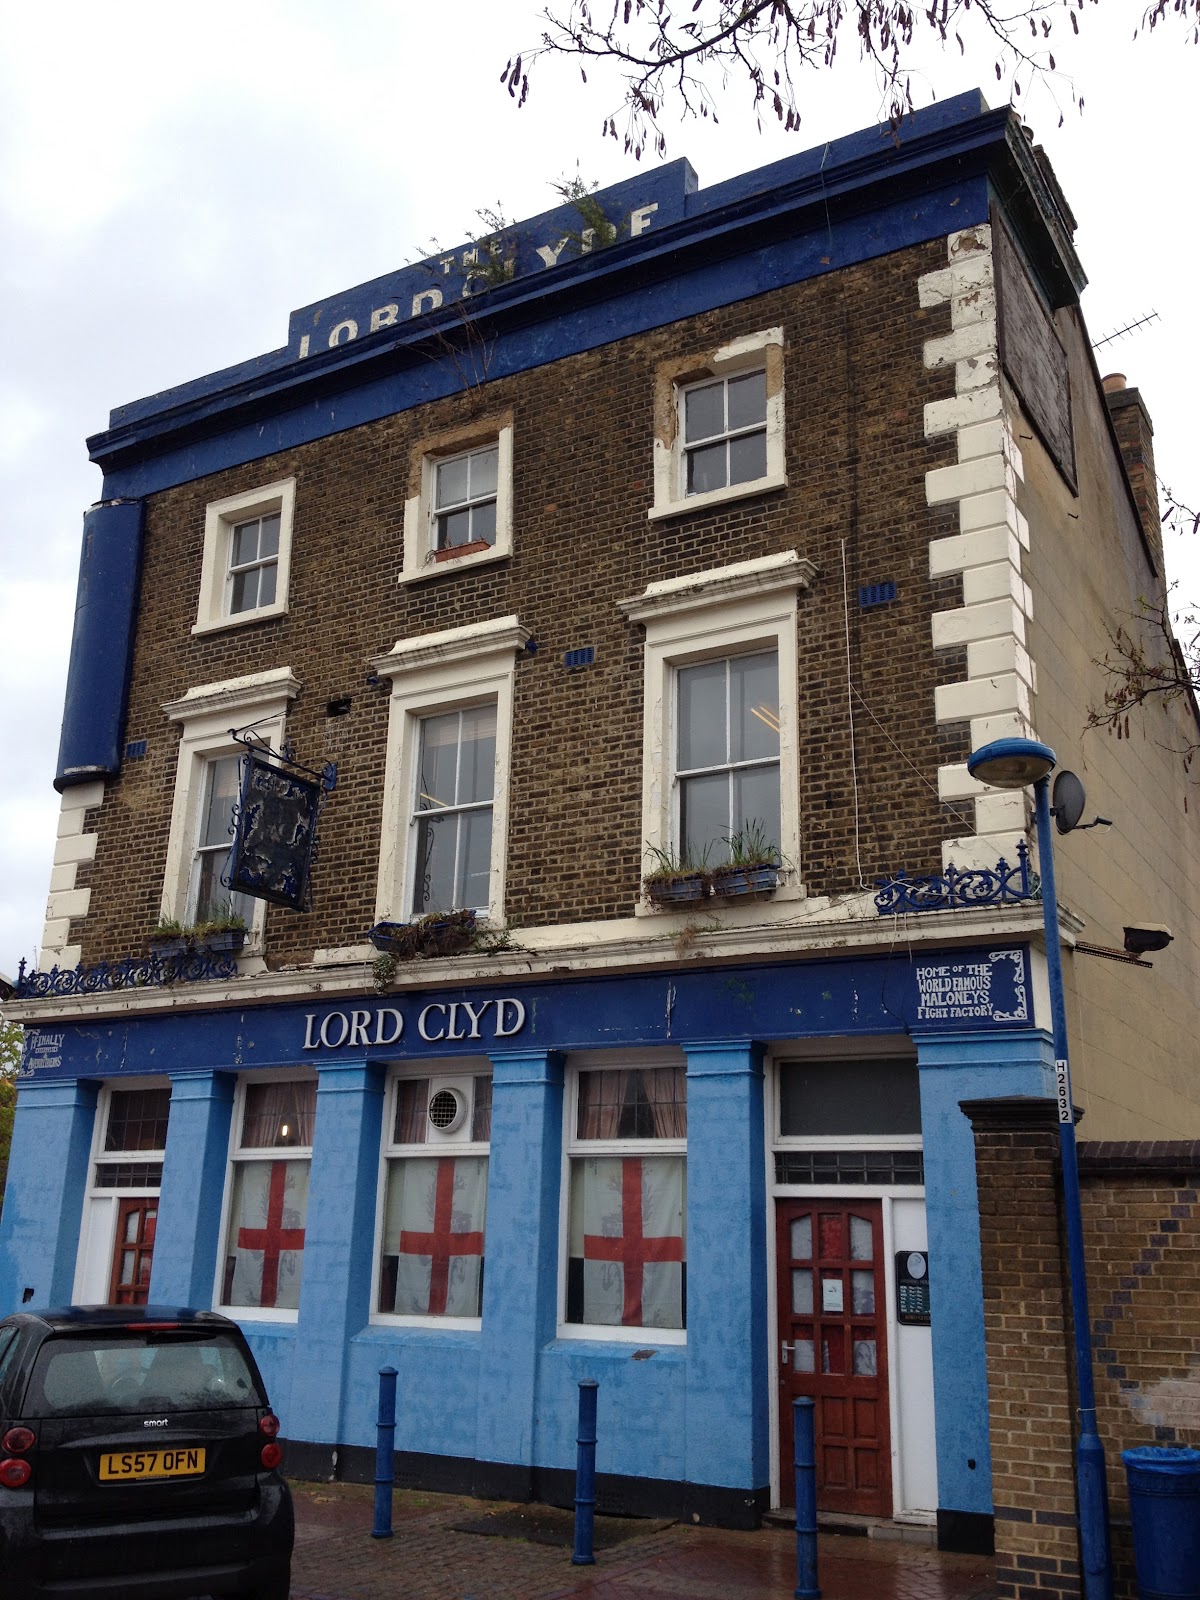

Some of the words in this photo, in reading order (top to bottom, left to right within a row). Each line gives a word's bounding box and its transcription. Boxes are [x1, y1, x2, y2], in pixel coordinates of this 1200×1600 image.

[916, 966, 950, 980] HOME
[952, 965, 964, 973] OF
[966, 964, 993, 976] THE
[918, 977, 952, 993] WORLD
[952, 975, 991, 992] FAMOUS
[921, 990, 990, 1007] MALONEYS
[917, 1006, 949, 1020] FIGHT
[950, 1003, 994, 1018] FACTORY
[302, 1008, 404, 1049] LORD
[418, 998, 525, 1042] CLYD
[143, 1418, 169, 1428] smart
[108, 1453, 158, 1474] LS57
[163, 1450, 198, 1471] OFN
